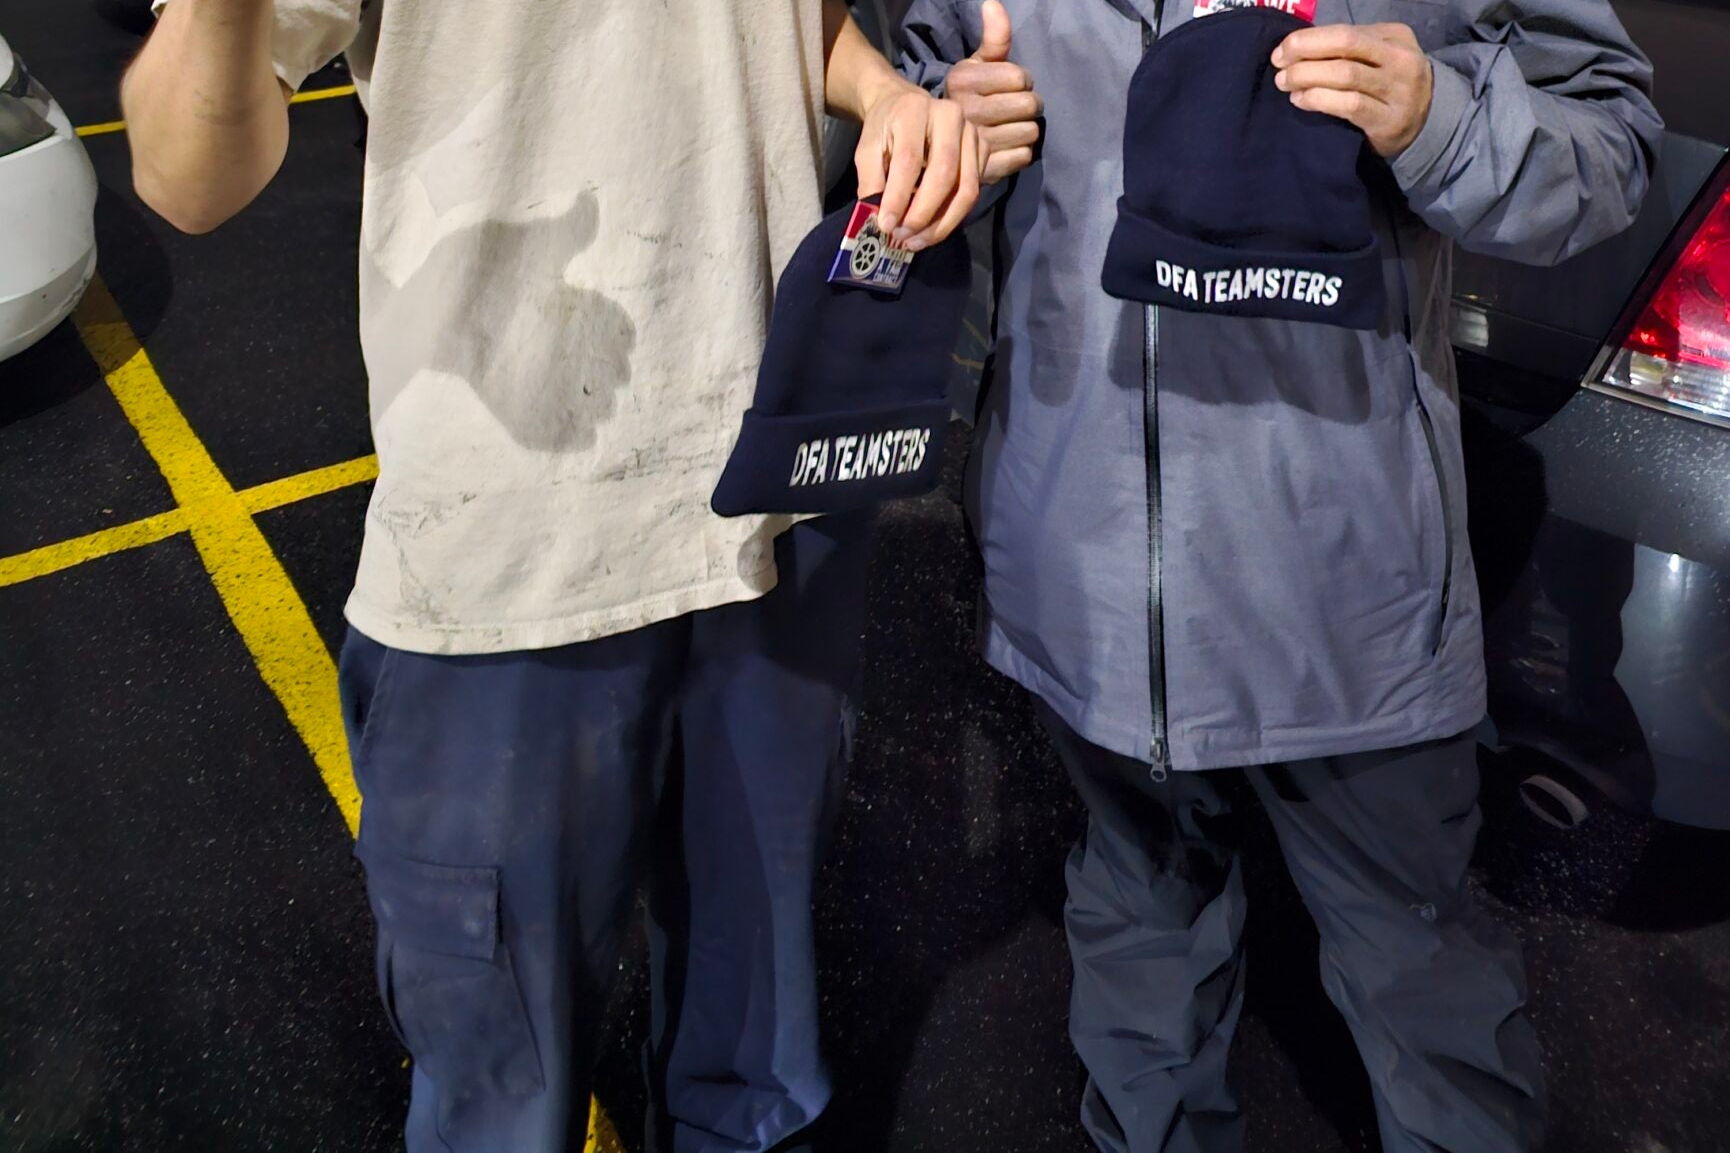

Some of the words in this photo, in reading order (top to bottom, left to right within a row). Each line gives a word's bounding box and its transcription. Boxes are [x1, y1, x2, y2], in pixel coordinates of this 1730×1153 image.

[1156, 259, 1198, 301] DFA
[1202, 267, 1343, 306] TEAMSTERS
[789, 437, 829, 487] DFA
[830, 427, 931, 481] TEAMSTERS
